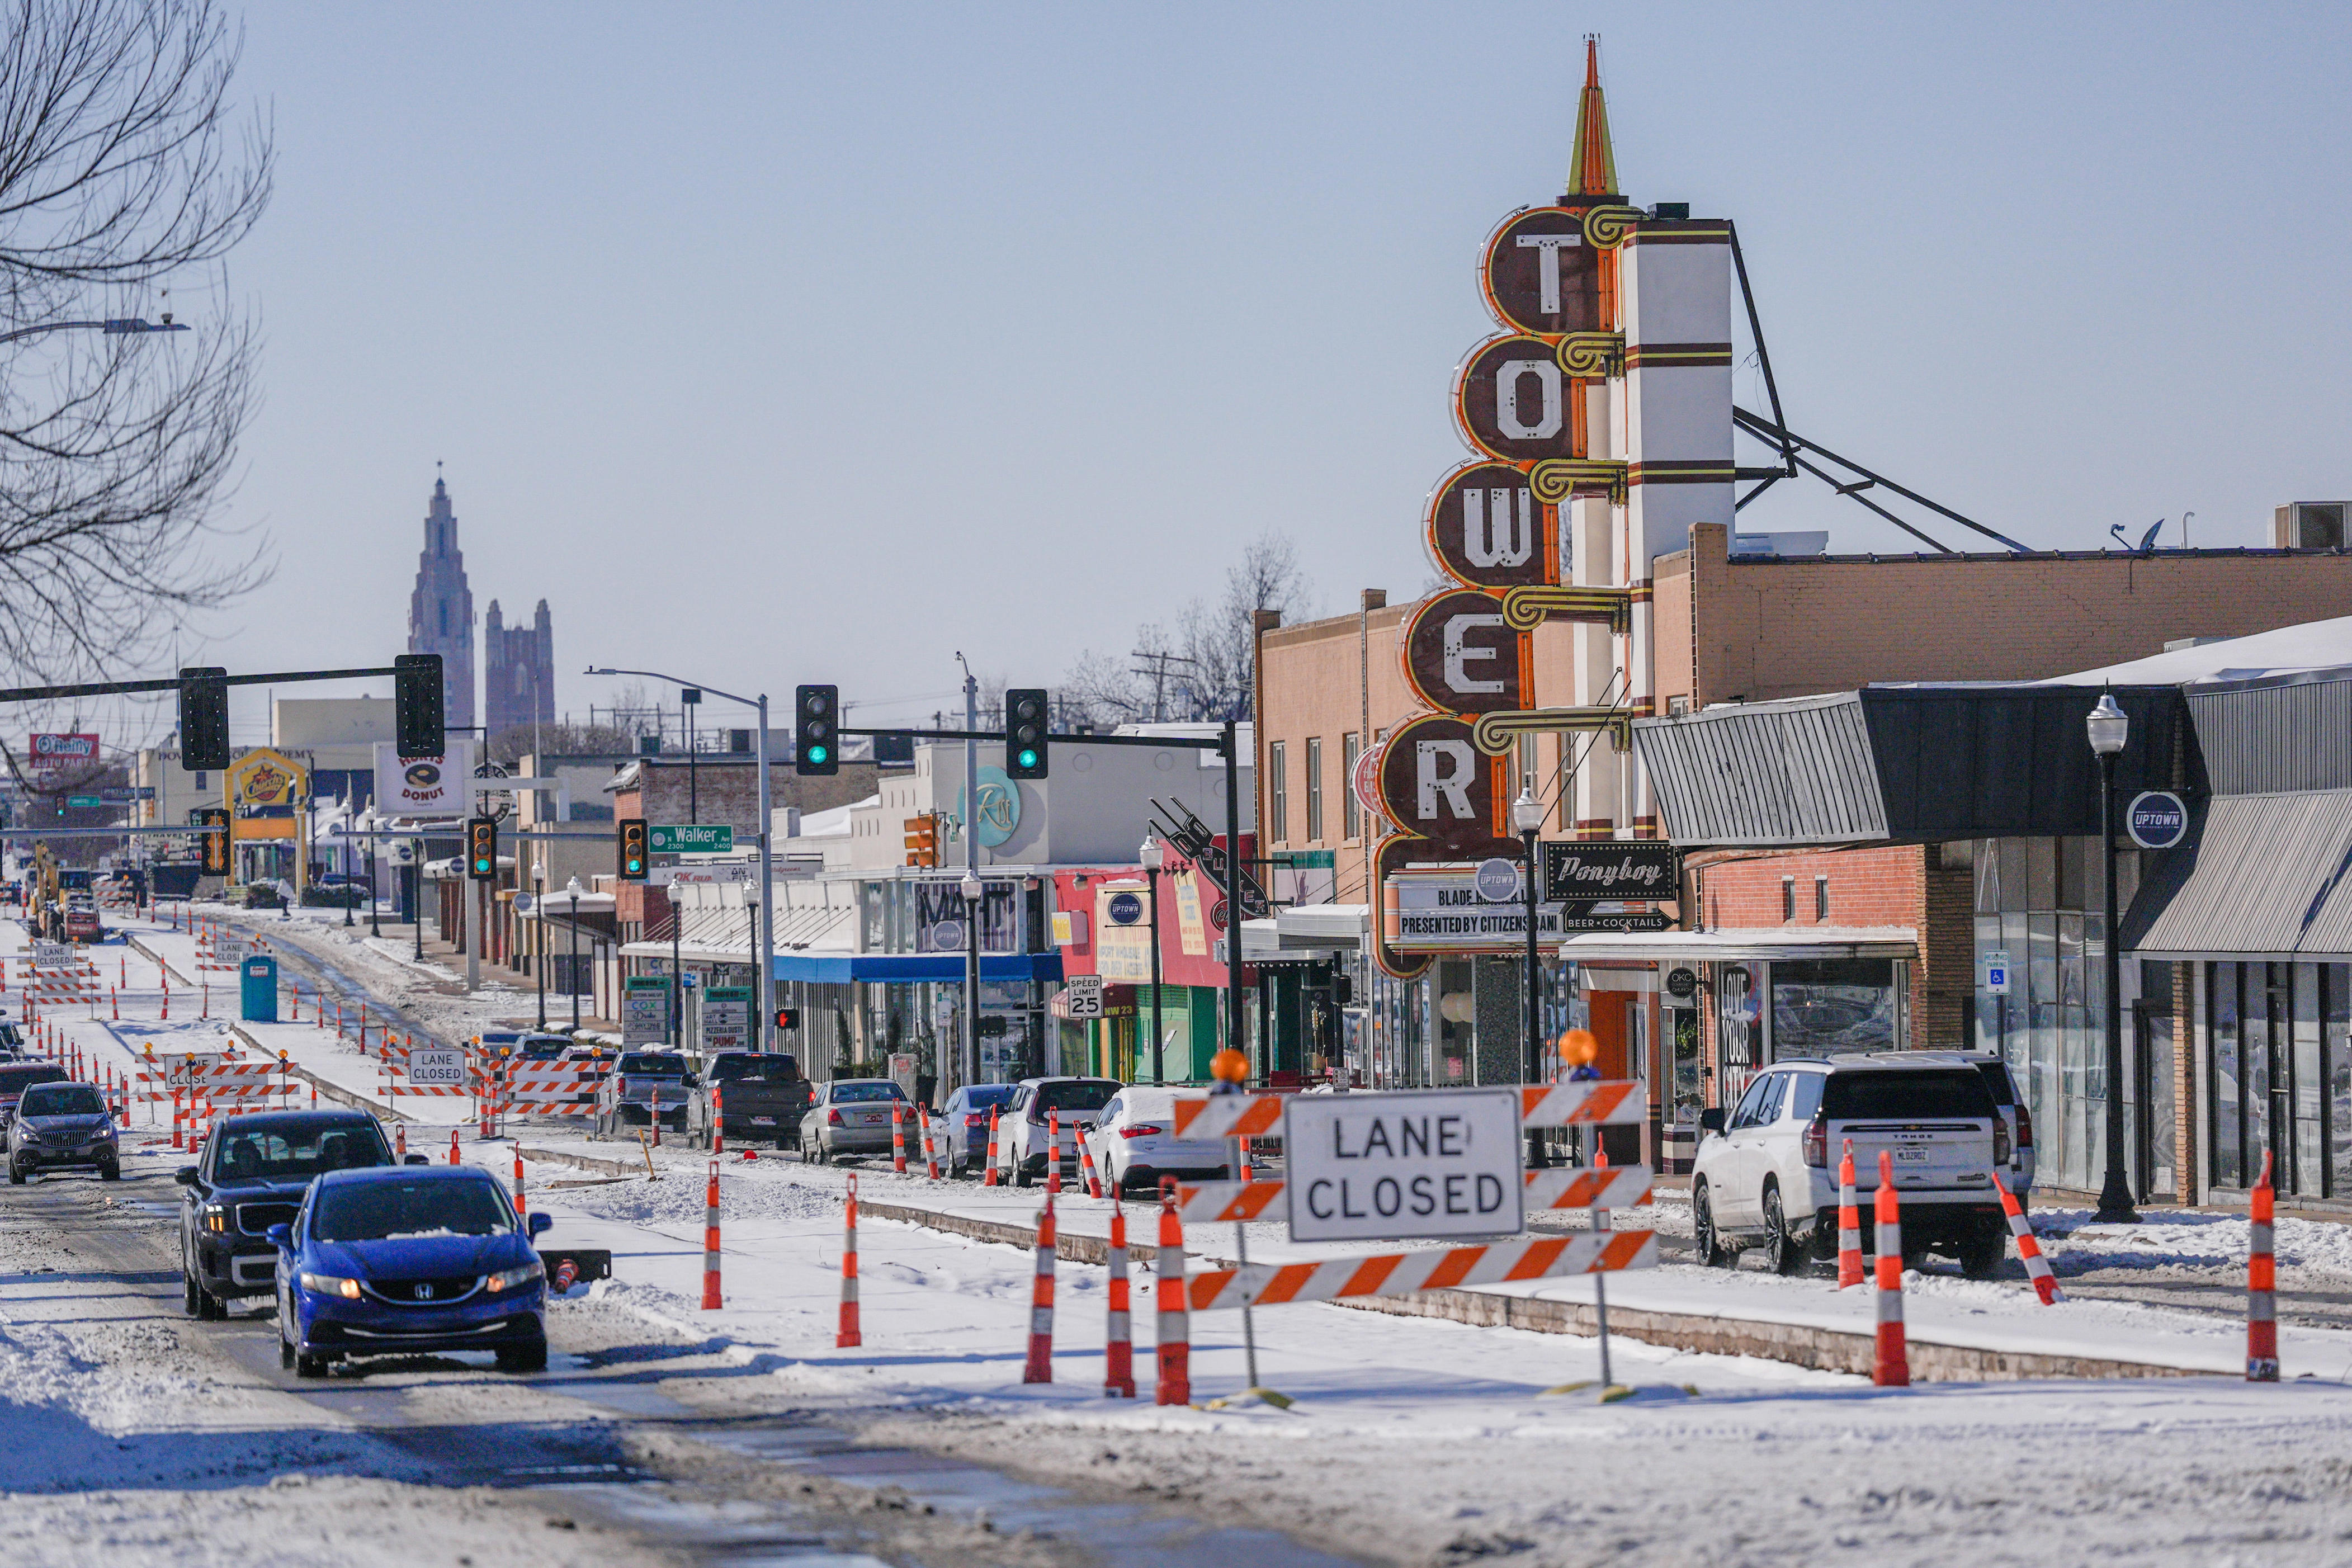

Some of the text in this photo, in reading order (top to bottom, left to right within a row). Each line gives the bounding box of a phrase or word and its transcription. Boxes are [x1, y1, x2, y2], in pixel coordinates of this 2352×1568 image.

[1416, 234, 1581, 820] TOWER
[402, 787, 445, 801] DONUT
[2136, 814, 2180, 825] UPTOWN
[675, 827, 717, 842] Walker
[1557, 856, 1663, 886] Ponyboy
[1480, 874, 1515, 884] UPTOWN
[1438, 890, 1472, 906] BLADE
[1402, 916, 1462, 933] PRESENTED
[1463, 916, 1478, 932] BY
[1481, 915, 1527, 932] CITIZENS
[1567, 918, 1663, 928] BEER COCKTAILS
[1671, 973, 1692, 982] OKC
[1721, 973, 1746, 1017] LOVE
[631, 1001, 657, 1010] COX
[1072, 997, 1099, 1013] 25
[1104, 1005, 1133, 1015] NW 23
[713, 1036, 736, 1046] PUMP
[1722, 1019, 1750, 1064] YOUR
[422, 1055, 452, 1065] LANE
[169, 1074, 206, 1084] CLOSE
[414, 1069, 461, 1079] CLOSED
[1723, 1065, 1746, 1109] CITY
[1334, 1115, 1463, 1158] LANE
[1307, 1173, 1503, 1220] CLOSED
